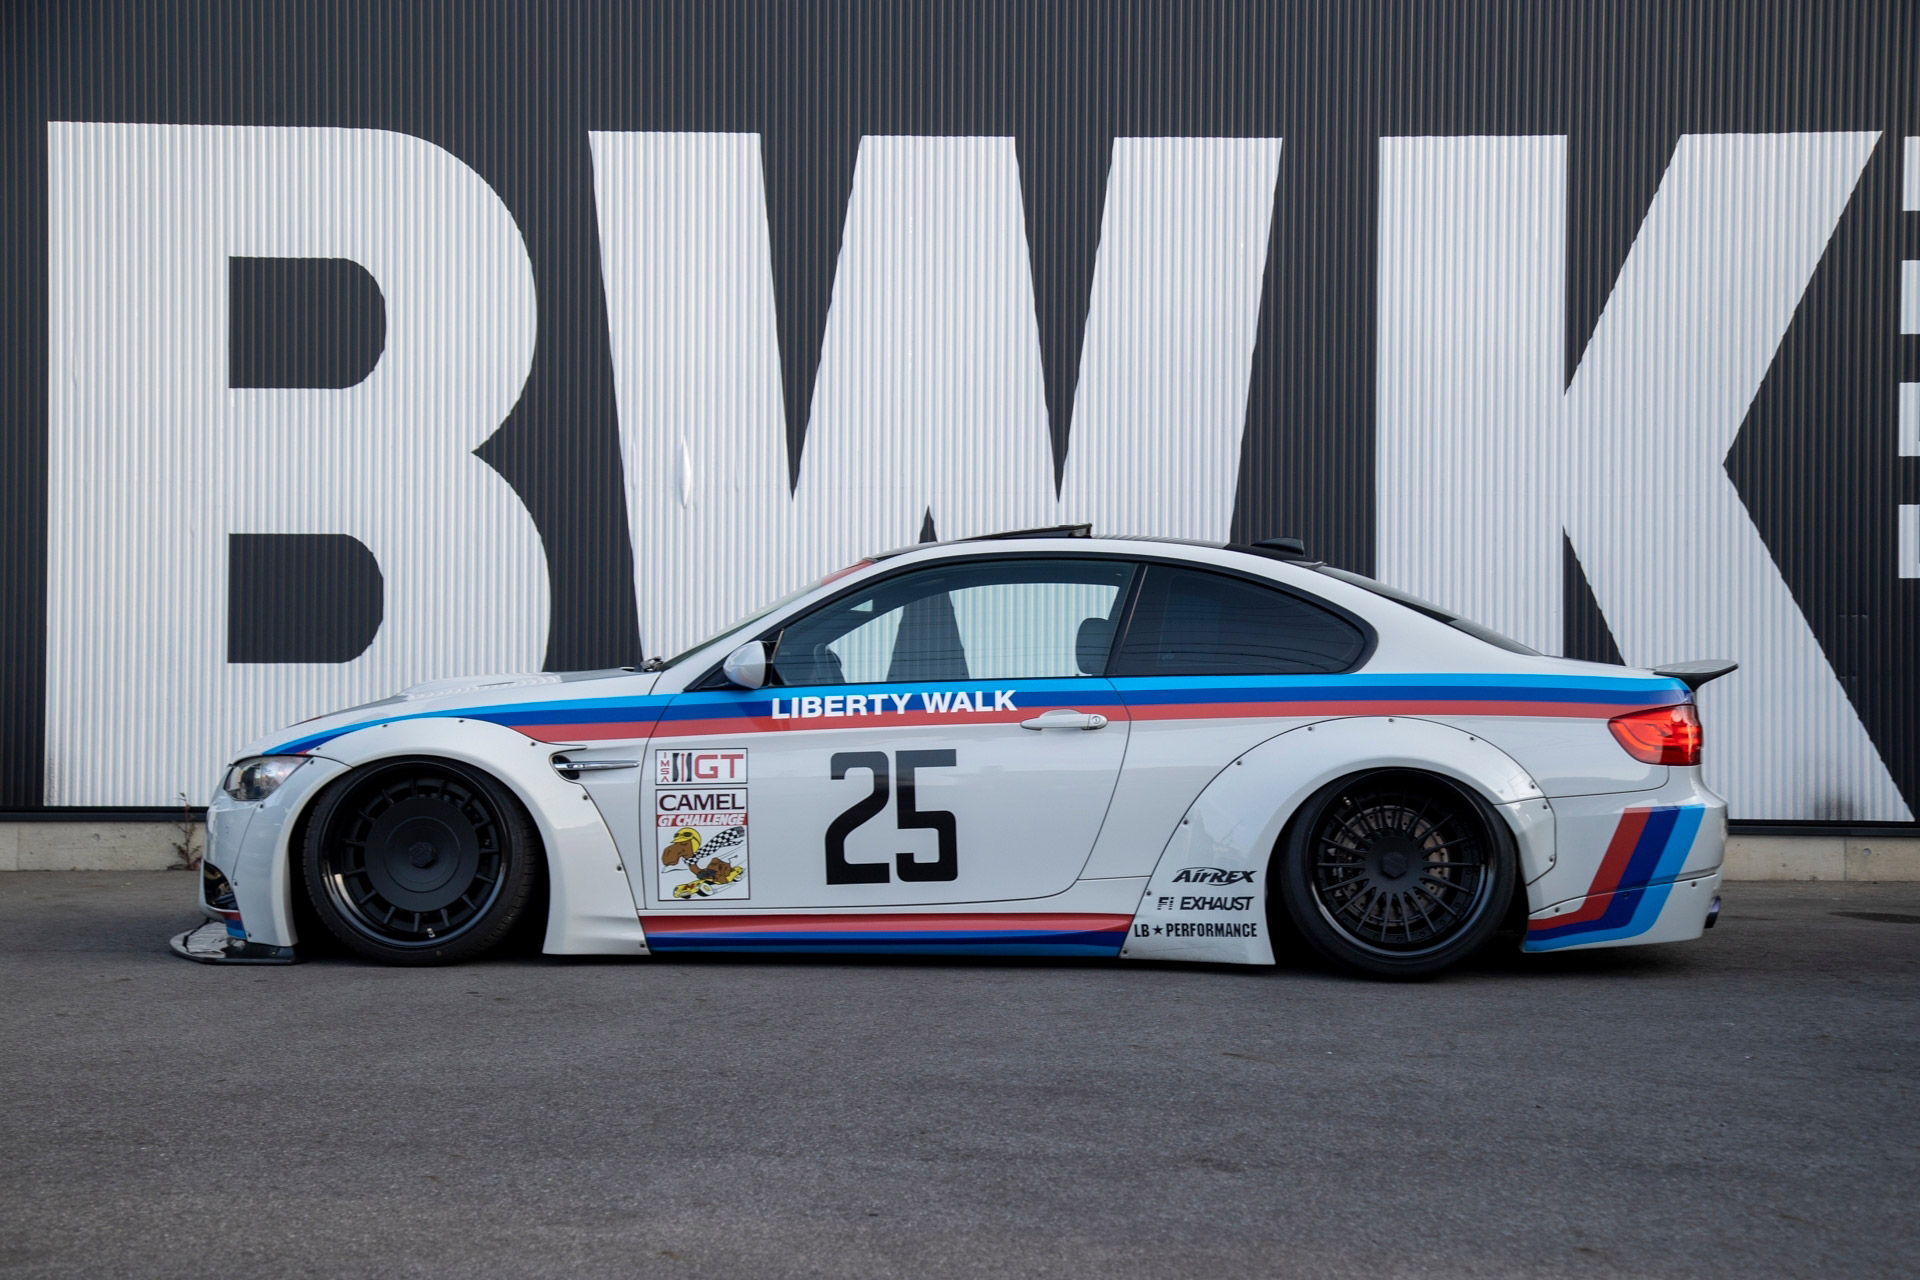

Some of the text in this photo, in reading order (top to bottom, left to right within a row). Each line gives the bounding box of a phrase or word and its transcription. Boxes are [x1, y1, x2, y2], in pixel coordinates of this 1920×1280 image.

[45, 121, 1915, 822] BWK
[771, 690, 1018, 719] LIBERTY WALK
[694, 753, 744, 779] GT
[659, 793, 745, 811] CAMEL
[658, 813, 745, 827] GT CHALLENGE
[825, 748, 958, 885] 25
[1180, 896, 1255, 910] EXHAUST
[1134, 923, 1257, 937] LB PERFORMANCE
